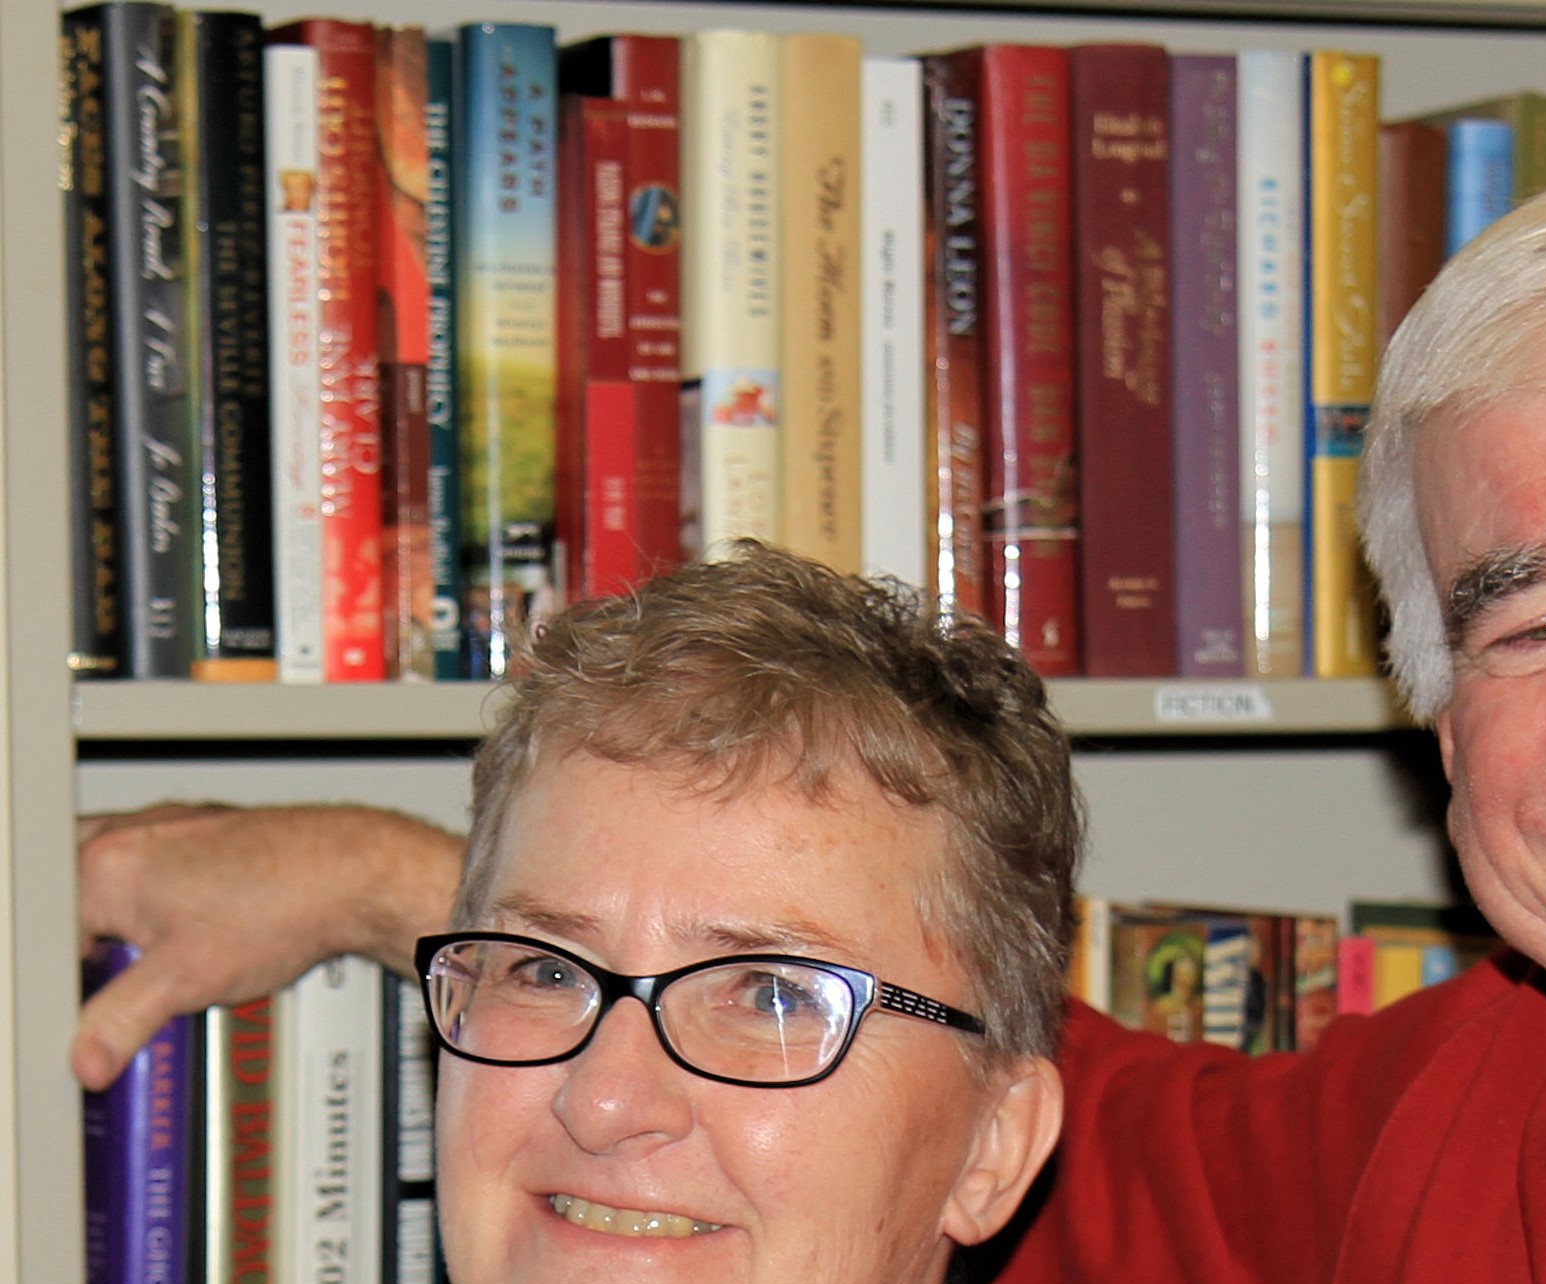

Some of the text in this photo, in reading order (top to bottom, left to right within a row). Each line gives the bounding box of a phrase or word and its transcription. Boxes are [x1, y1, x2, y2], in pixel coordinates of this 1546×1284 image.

[129, 87, 170, 191] Country
[425, 101, 453, 431] THE CELESTINE PROPHECY
[945, 98, 977, 335] DONNA LEON
[1258, 176, 1279, 320] RICHARD
[217, 284, 241, 392] SEVILLE
[285, 217, 311, 368] FEARLESS
[351, 355, 378, 474] CLARK
[147, 476, 182, 555] Baker
[219, 401, 246, 601] COMMUNION
[1161, 695, 1253, 716] FICTION
[149, 1041, 173, 1150] BARKER
[229, 1000, 274, 1083] VID
[146, 1165, 174, 1217] THE
[315, 1050, 351, 1222] Minutes
